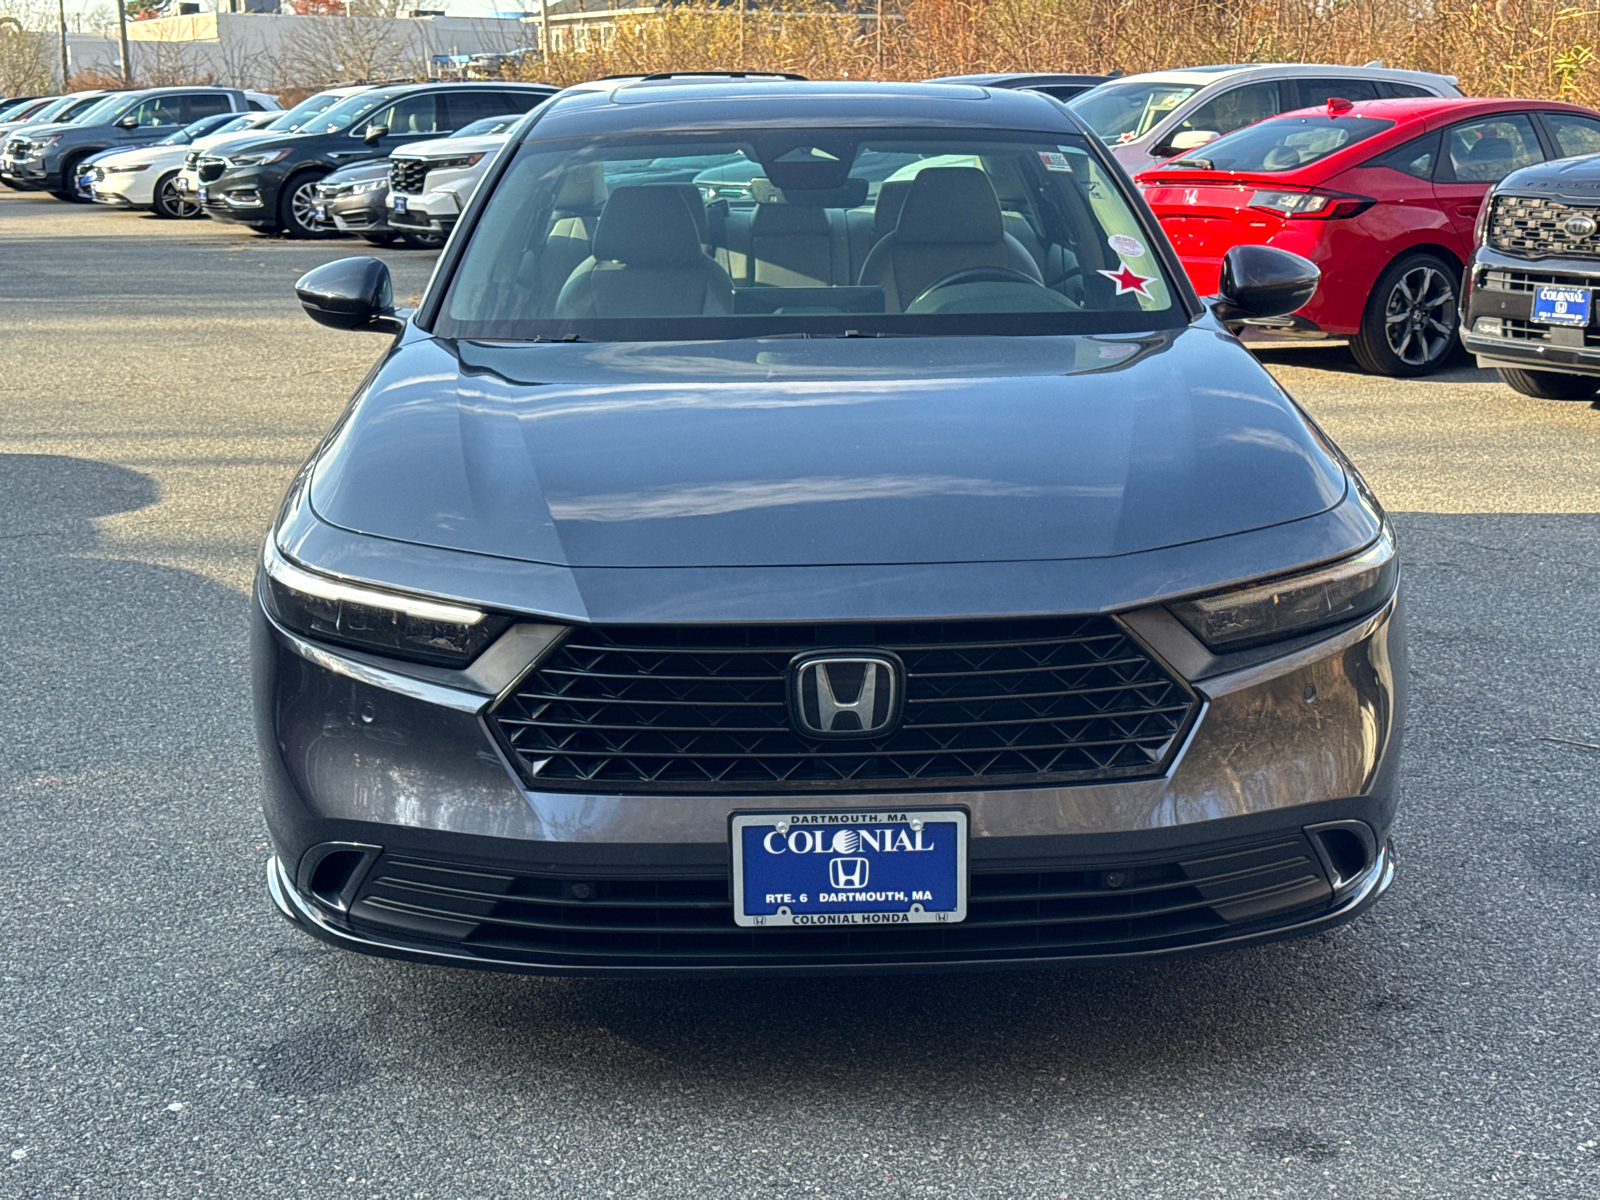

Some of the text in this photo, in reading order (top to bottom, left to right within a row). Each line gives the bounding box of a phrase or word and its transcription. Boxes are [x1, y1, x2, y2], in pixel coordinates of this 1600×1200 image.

[791, 813, 908, 824] DARTMOUTH, MA
[763, 829, 934, 854] COLONIAL
[766, 891, 933, 904] RTE. 6 DARTMOUTH, MA
[792, 913, 909, 925] COLONIAL HONDA
